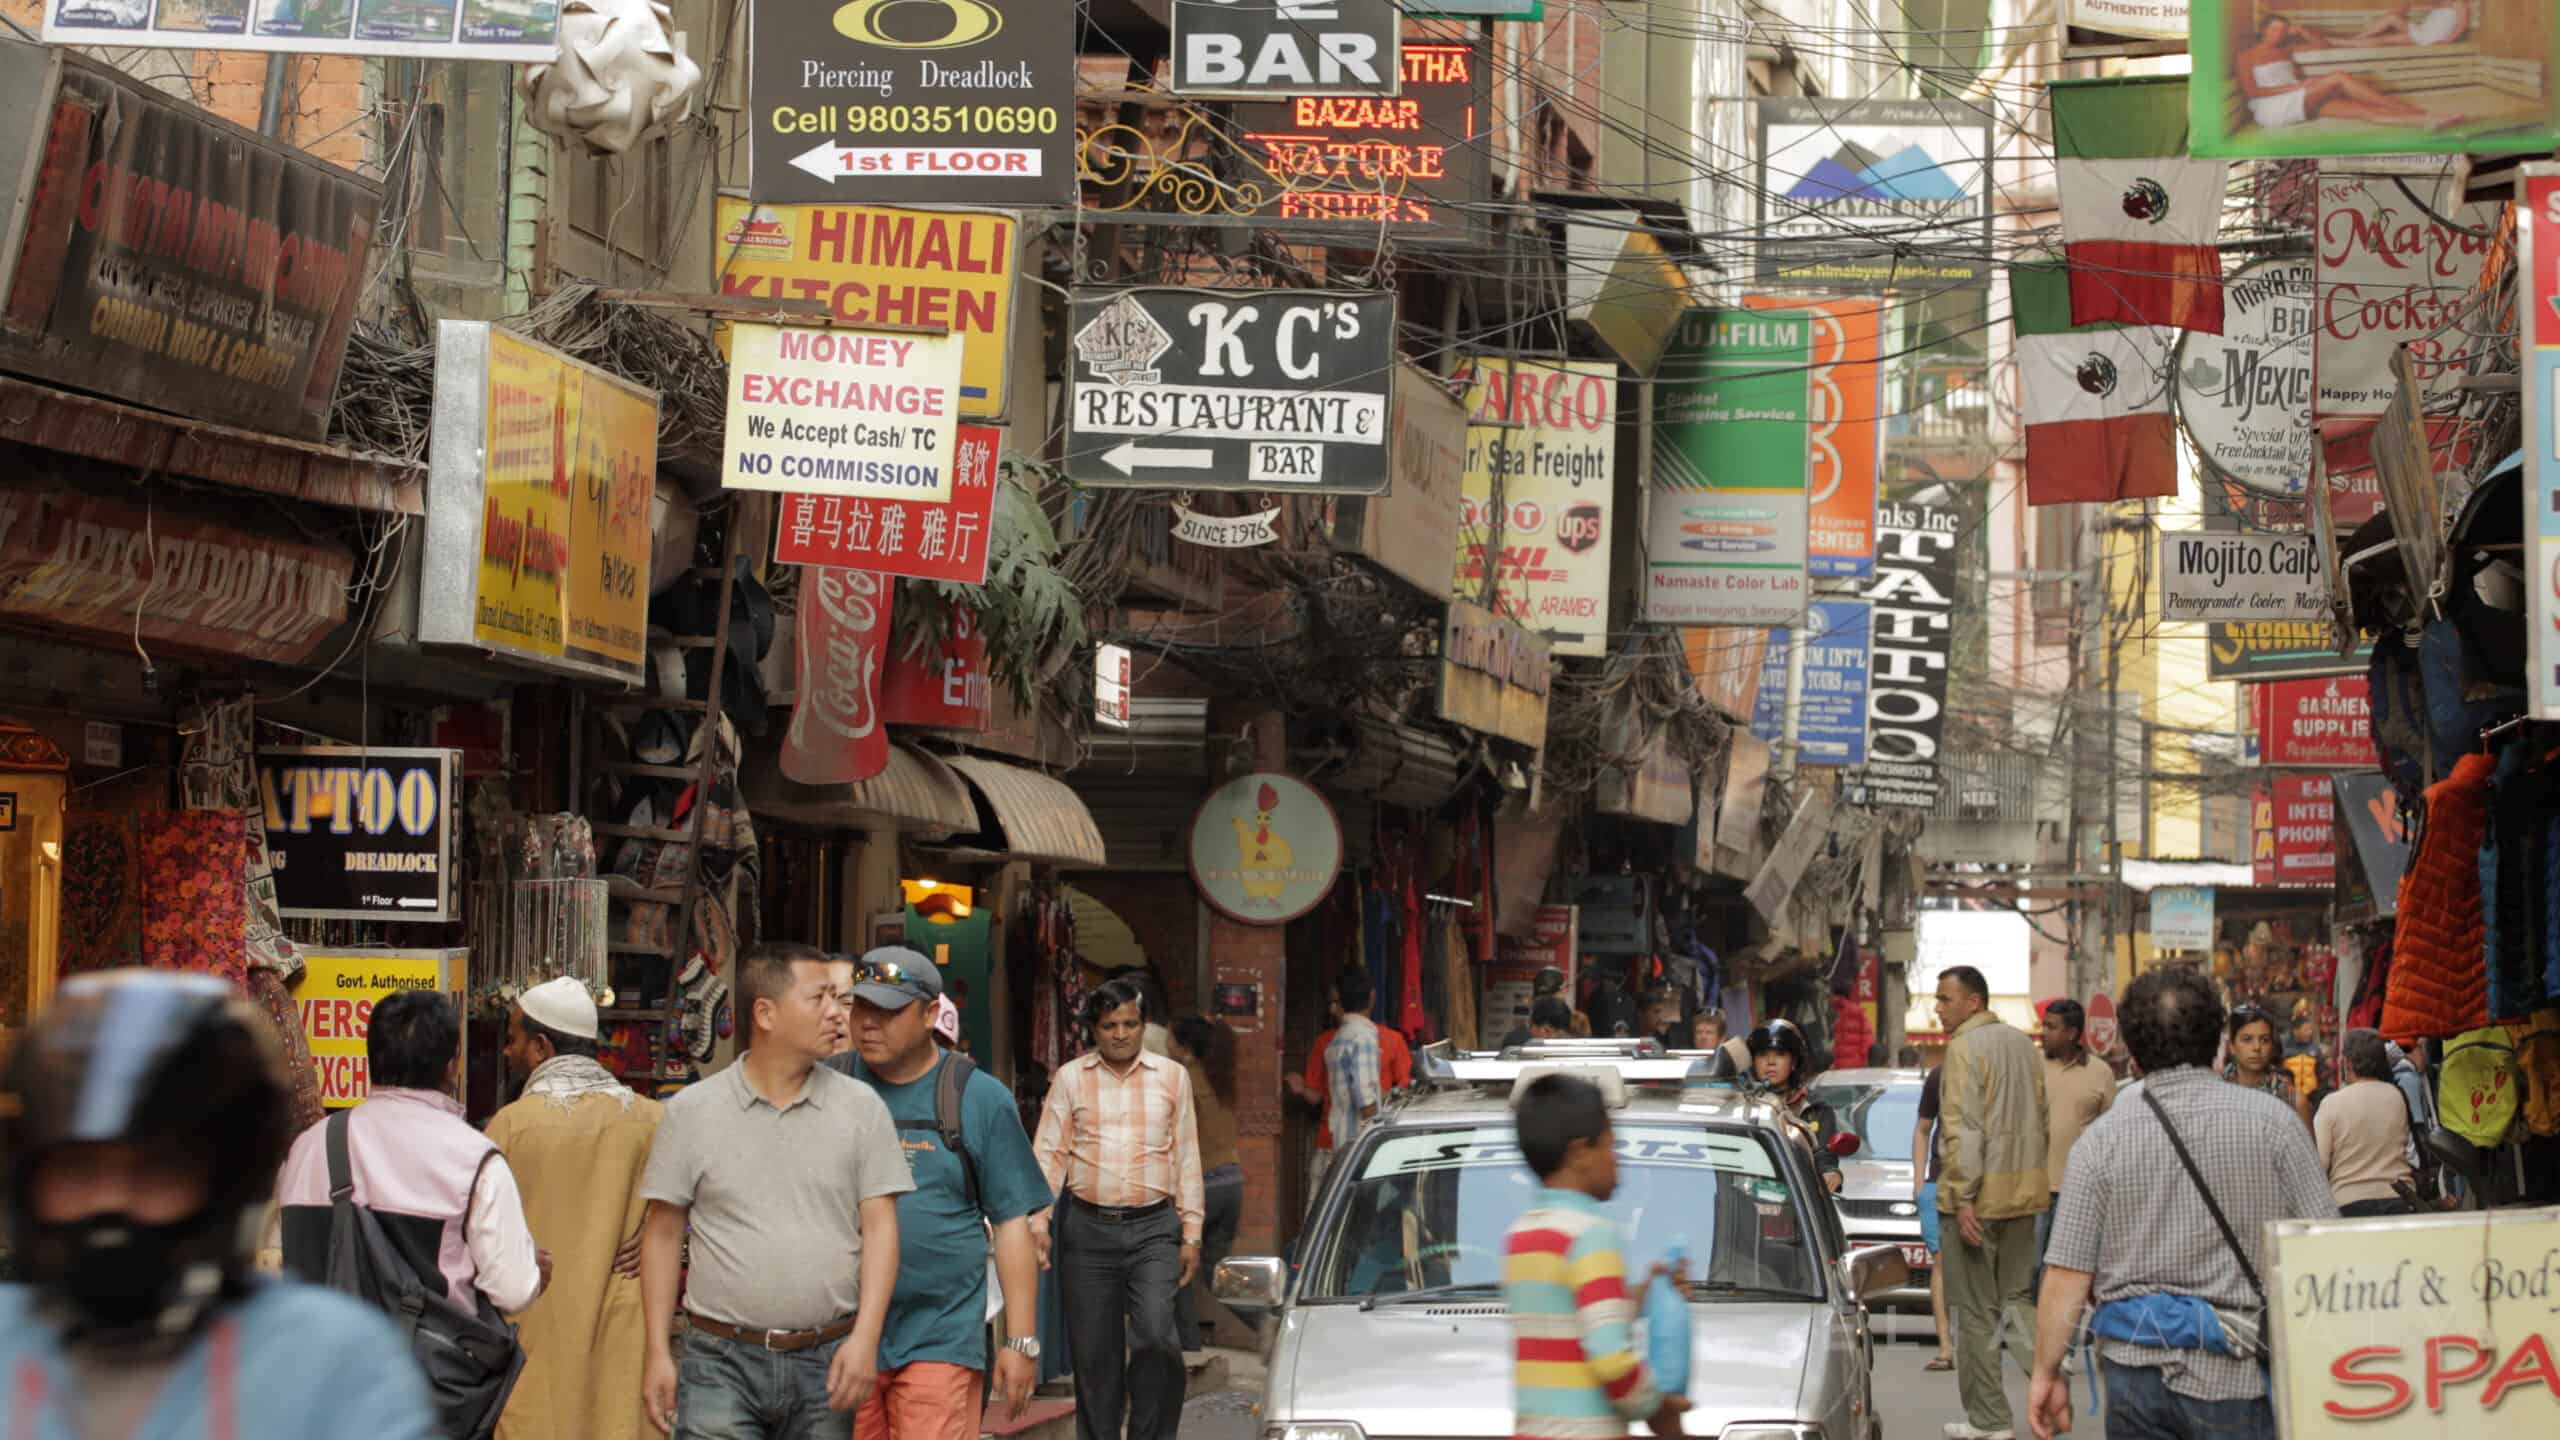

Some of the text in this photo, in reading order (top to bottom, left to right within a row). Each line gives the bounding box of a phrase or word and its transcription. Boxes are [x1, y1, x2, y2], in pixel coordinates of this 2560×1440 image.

[1186, 33, 1382, 84] BAR
[800, 60, 1033, 97] Piercing Dreadlock
[772, 106, 1057, 133] Cell 9803510690
[1296, 98, 1420, 129] BAZAAR
[839, 152, 1028, 172] 1st FLOOR
[808, 210, 1007, 275] HIMALI
[2323, 207, 2492, 277] Maya
[780, 332, 914, 369] MONEY
[742, 374, 945, 417] EXCHANGE
[2321, 388, 2369, 403] Happy
[1079, 389, 1352, 435] RESTAURANT
[1733, 407, 1797, 421] Service
[747, 415, 936, 452] We Accept Cash/ TC
[738, 452, 940, 488] NO COMMISSION
[1258, 444, 1316, 476] BAR
[1532, 442, 1605, 488] Freight
[1181, 516, 1270, 544] SINCE 1976
[1559, 516, 1599, 548] ups
[1923, 505, 1959, 532] Inc
[1653, 573, 1800, 591] Namaste Color Lab
[1538, 594, 1599, 618] ARAMEX
[2167, 592, 2244, 615] Pomegranate
[1860, 527, 1955, 763] TATTOO
[345, 851, 438, 873] DREADLOCK
[372, 894, 394, 907] Floor
[336, 973, 436, 990] Govt. Authorised
[2294, 1259, 2412, 1318] Mind
[2418, 1264, 2448, 1306] &
[2322, 1332, 2560, 1420] SPA
